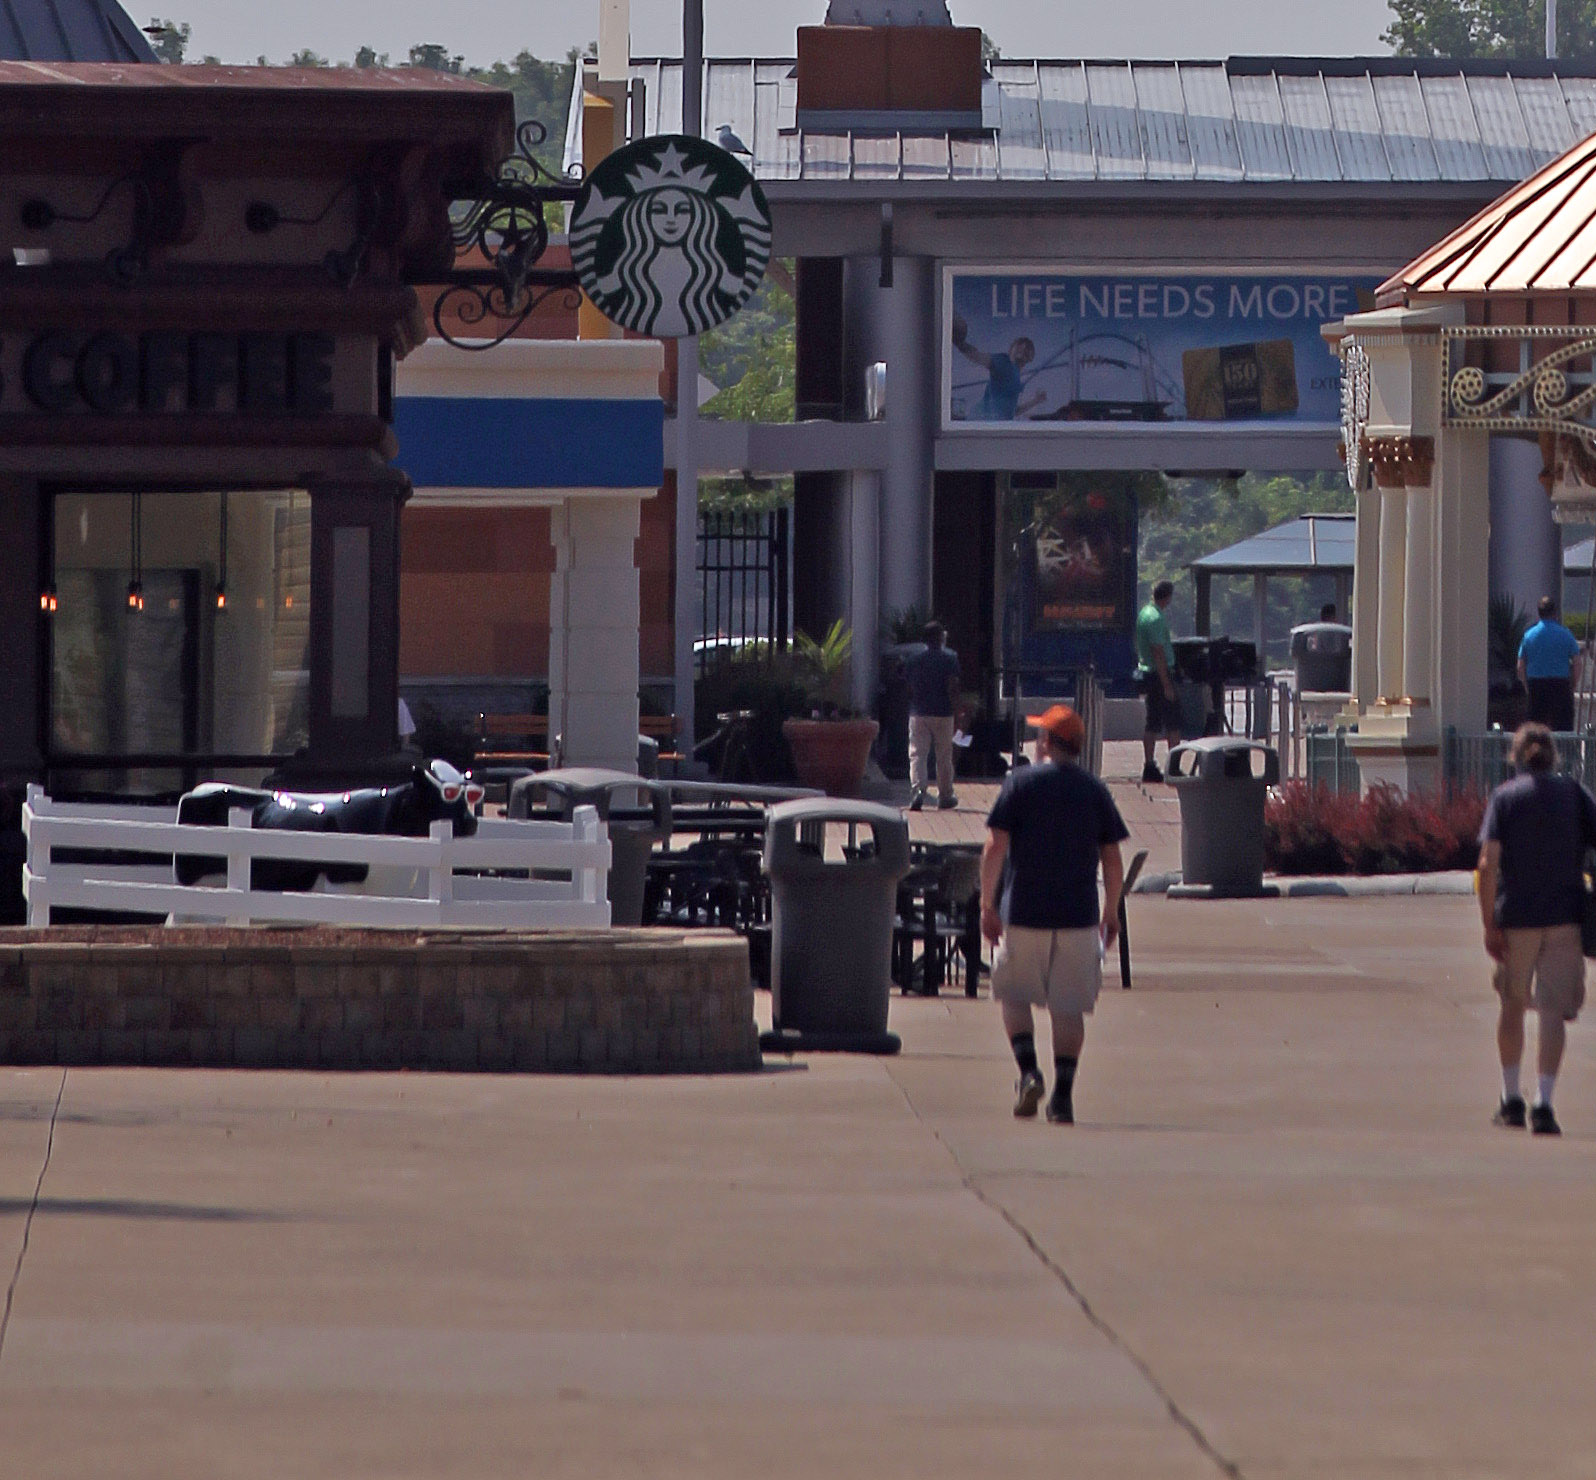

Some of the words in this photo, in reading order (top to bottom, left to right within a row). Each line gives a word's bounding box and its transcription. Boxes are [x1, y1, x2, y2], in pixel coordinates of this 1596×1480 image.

[991, 284, 1066, 319] LIFE
[1079, 284, 1216, 319] NEEDS
[1228, 284, 1350, 319] MORE
[22, 329, 335, 411] COFFEE
